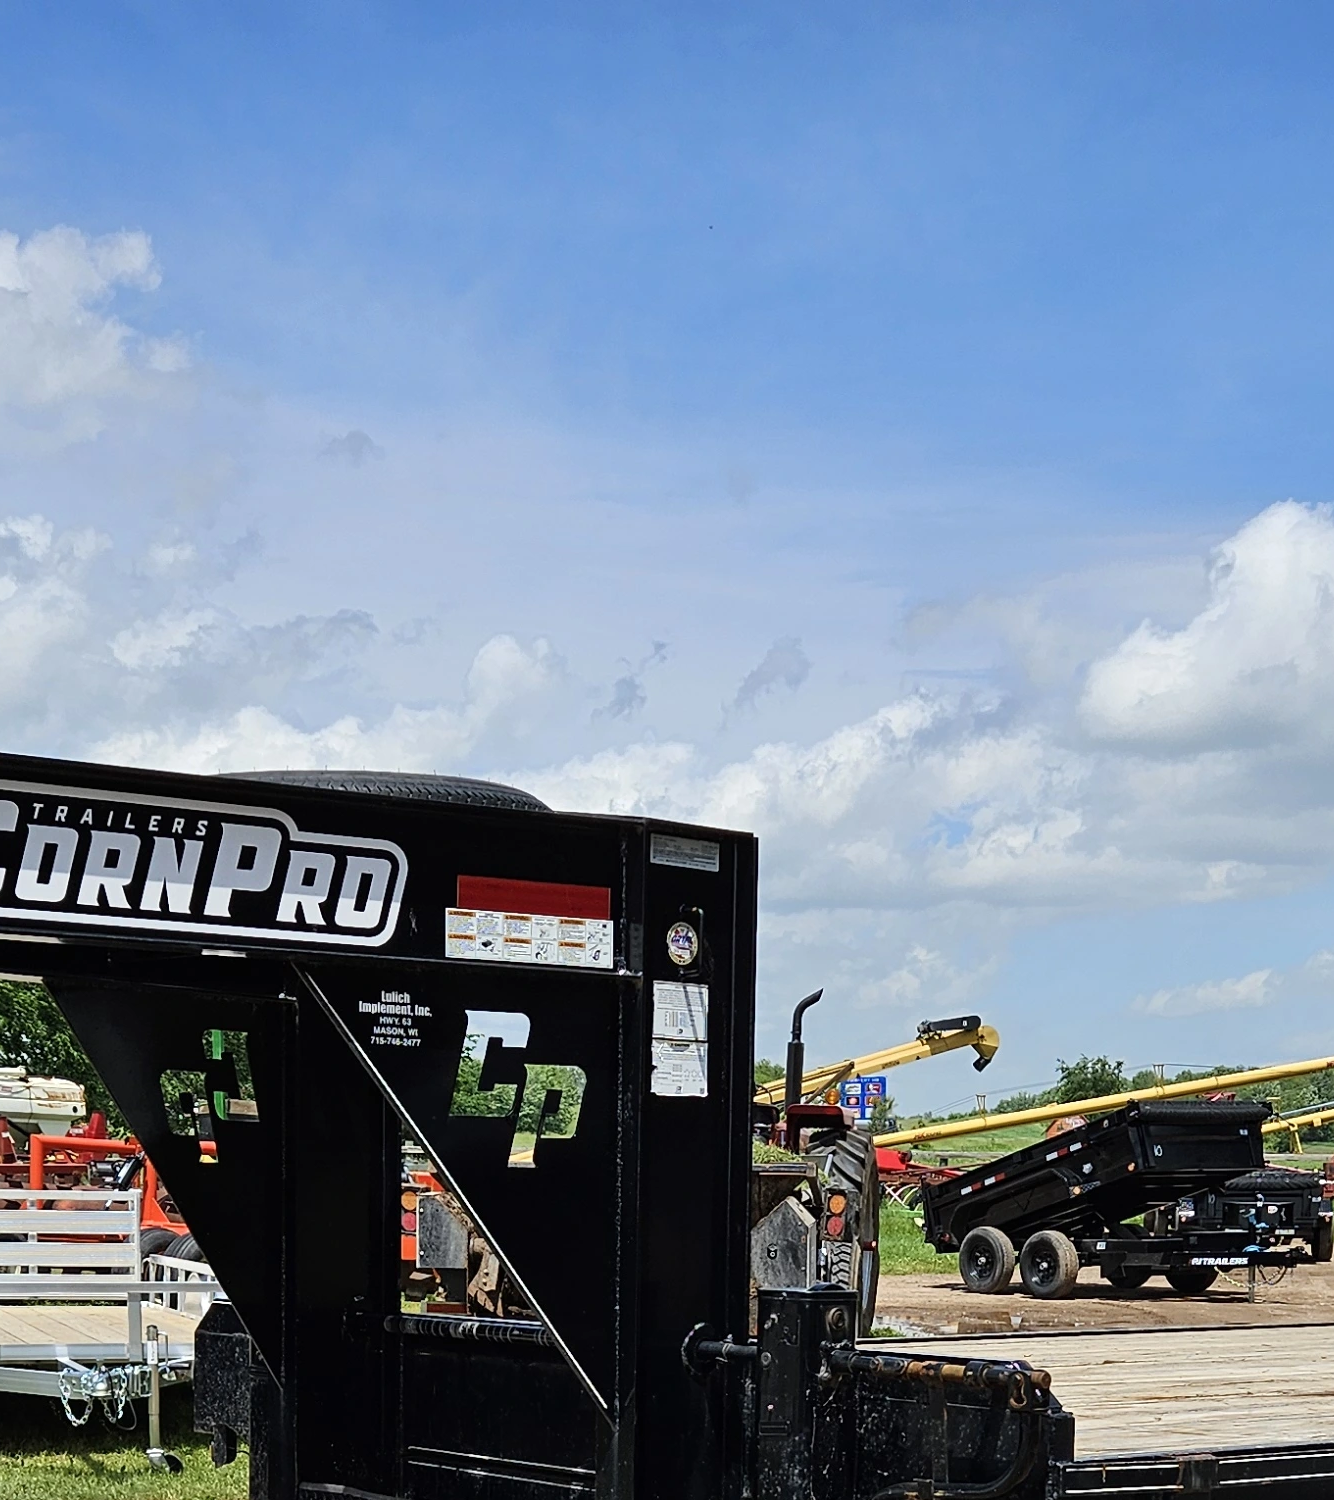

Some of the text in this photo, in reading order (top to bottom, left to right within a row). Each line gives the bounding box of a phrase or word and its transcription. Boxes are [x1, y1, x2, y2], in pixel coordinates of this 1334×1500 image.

[32, 802, 209, 838] TRAILERS
[381, 990, 411, 1003] Lulich
[414, 1004, 433, 1017] Inc.
[402, 1017, 412, 1026] 63
[373, 1026, 419, 1037] MASON, WI
